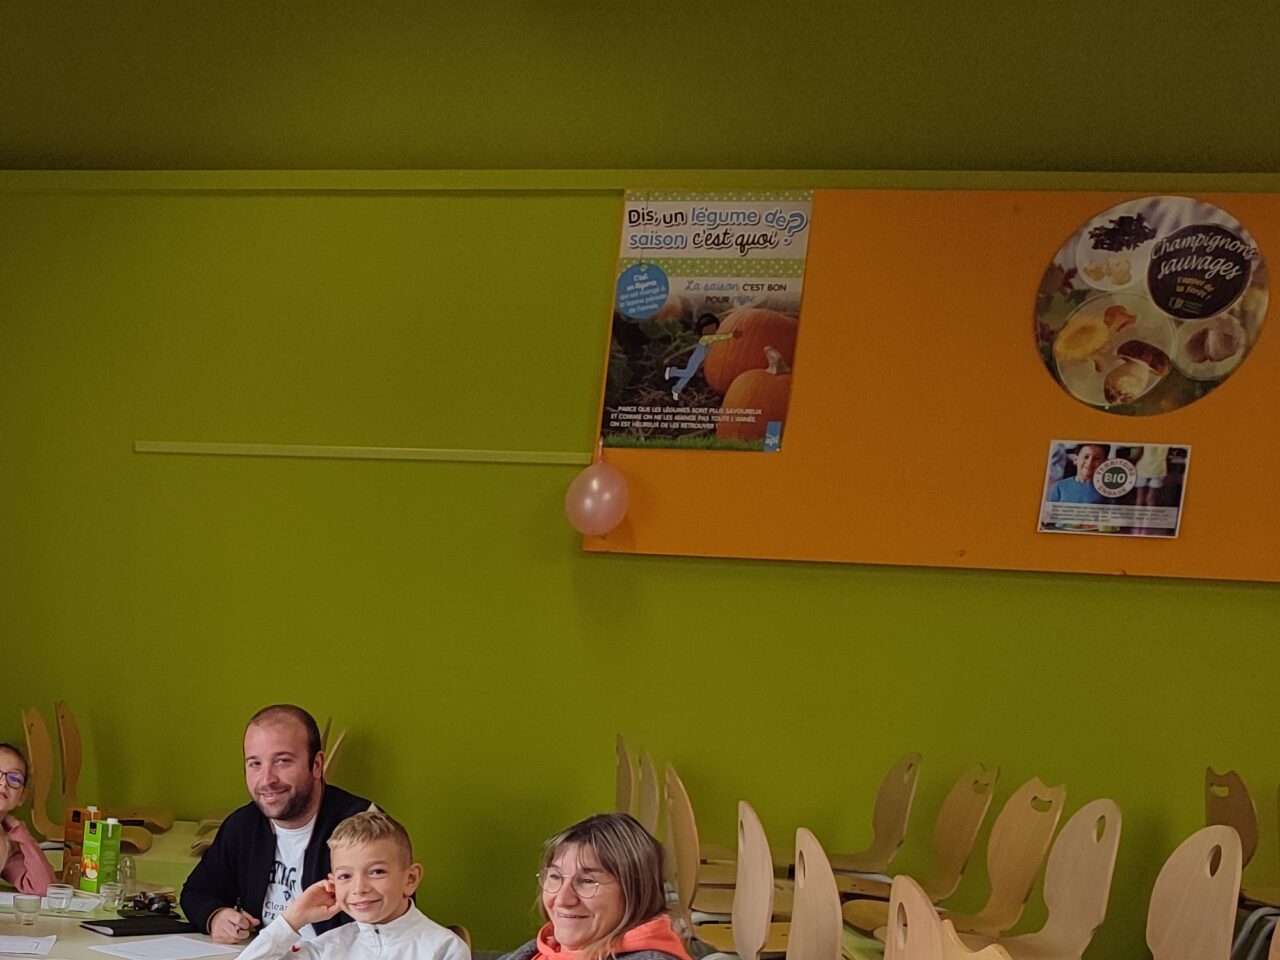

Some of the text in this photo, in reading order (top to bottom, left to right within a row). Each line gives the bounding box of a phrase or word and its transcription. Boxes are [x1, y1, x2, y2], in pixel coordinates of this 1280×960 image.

[628, 207, 660, 225] Dis,
[663, 209, 685, 224] un
[691, 207, 759, 227] légume
[630, 230, 685, 246] saison
[692, 228, 732, 246] c'est
[1151, 232, 1258, 260] Champignons
[1157, 254, 1242, 280] sauvages
[742, 283, 765, 292] C'EST
[767, 283, 787, 291] BON
[705, 296, 730, 304] POUR
[1104, 472, 1126, 483] BIO
